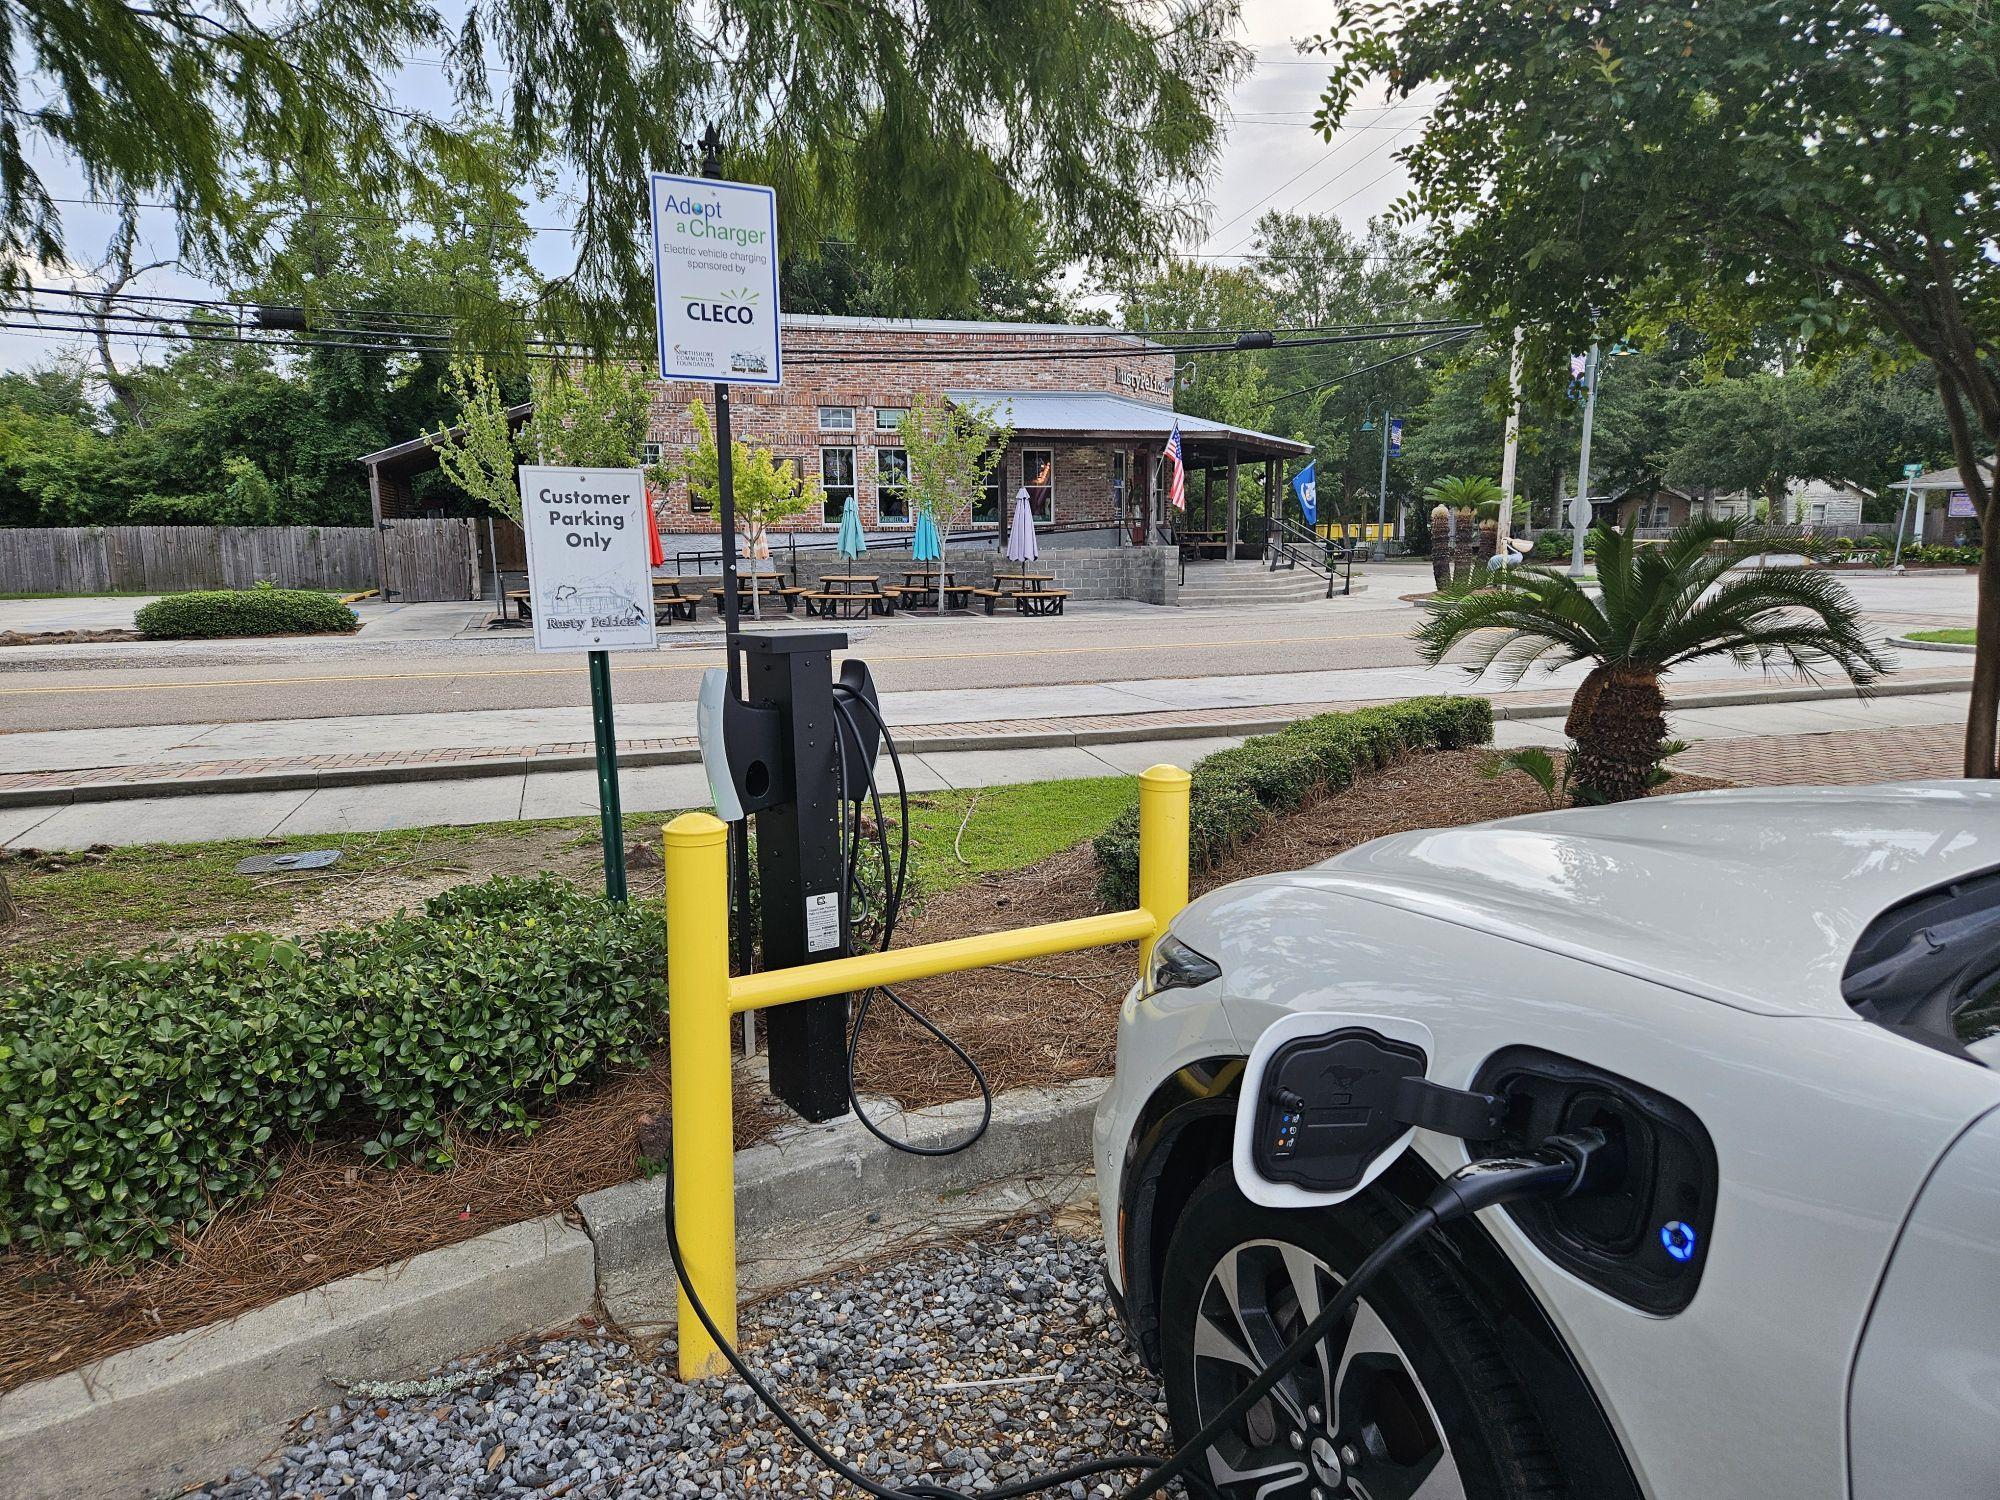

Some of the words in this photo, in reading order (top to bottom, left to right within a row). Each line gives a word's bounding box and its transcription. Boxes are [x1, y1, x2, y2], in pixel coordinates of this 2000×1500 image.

[665, 195, 722, 220] Adopt
[677, 222, 686, 233] a
[690, 219, 766, 247] Charger
[664, 243, 696, 256] Electric
[698, 248, 728, 259] vehicle
[730, 252, 767, 265] charging
[687, 260, 733, 272] sponsored
[735, 264, 746, 275] by
[687, 302, 754, 325] CLECO
[539, 488, 631, 505] Customer
[550, 510, 625, 531] Parking
[566, 532, 612, 551] Only
[546, 617, 587, 631] Rusty
